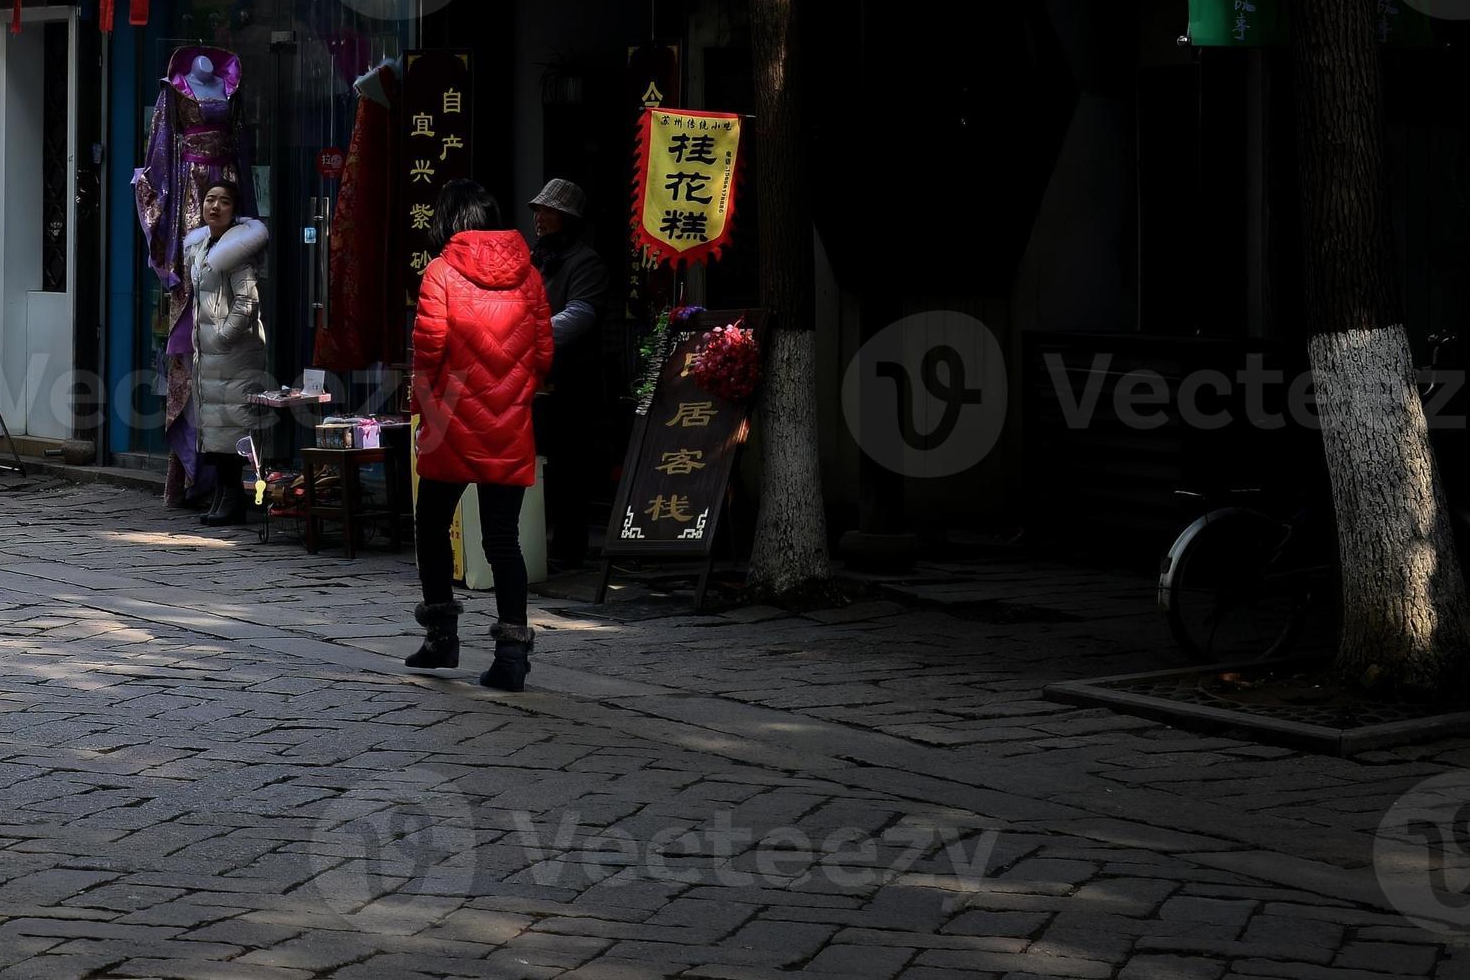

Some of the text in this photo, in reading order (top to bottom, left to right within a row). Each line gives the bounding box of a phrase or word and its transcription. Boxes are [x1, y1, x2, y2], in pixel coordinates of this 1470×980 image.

[440, 88, 464, 161] 自产
[410, 112, 435, 276] 宜兴紫砂
[660, 133, 717, 242] 桂花糕
